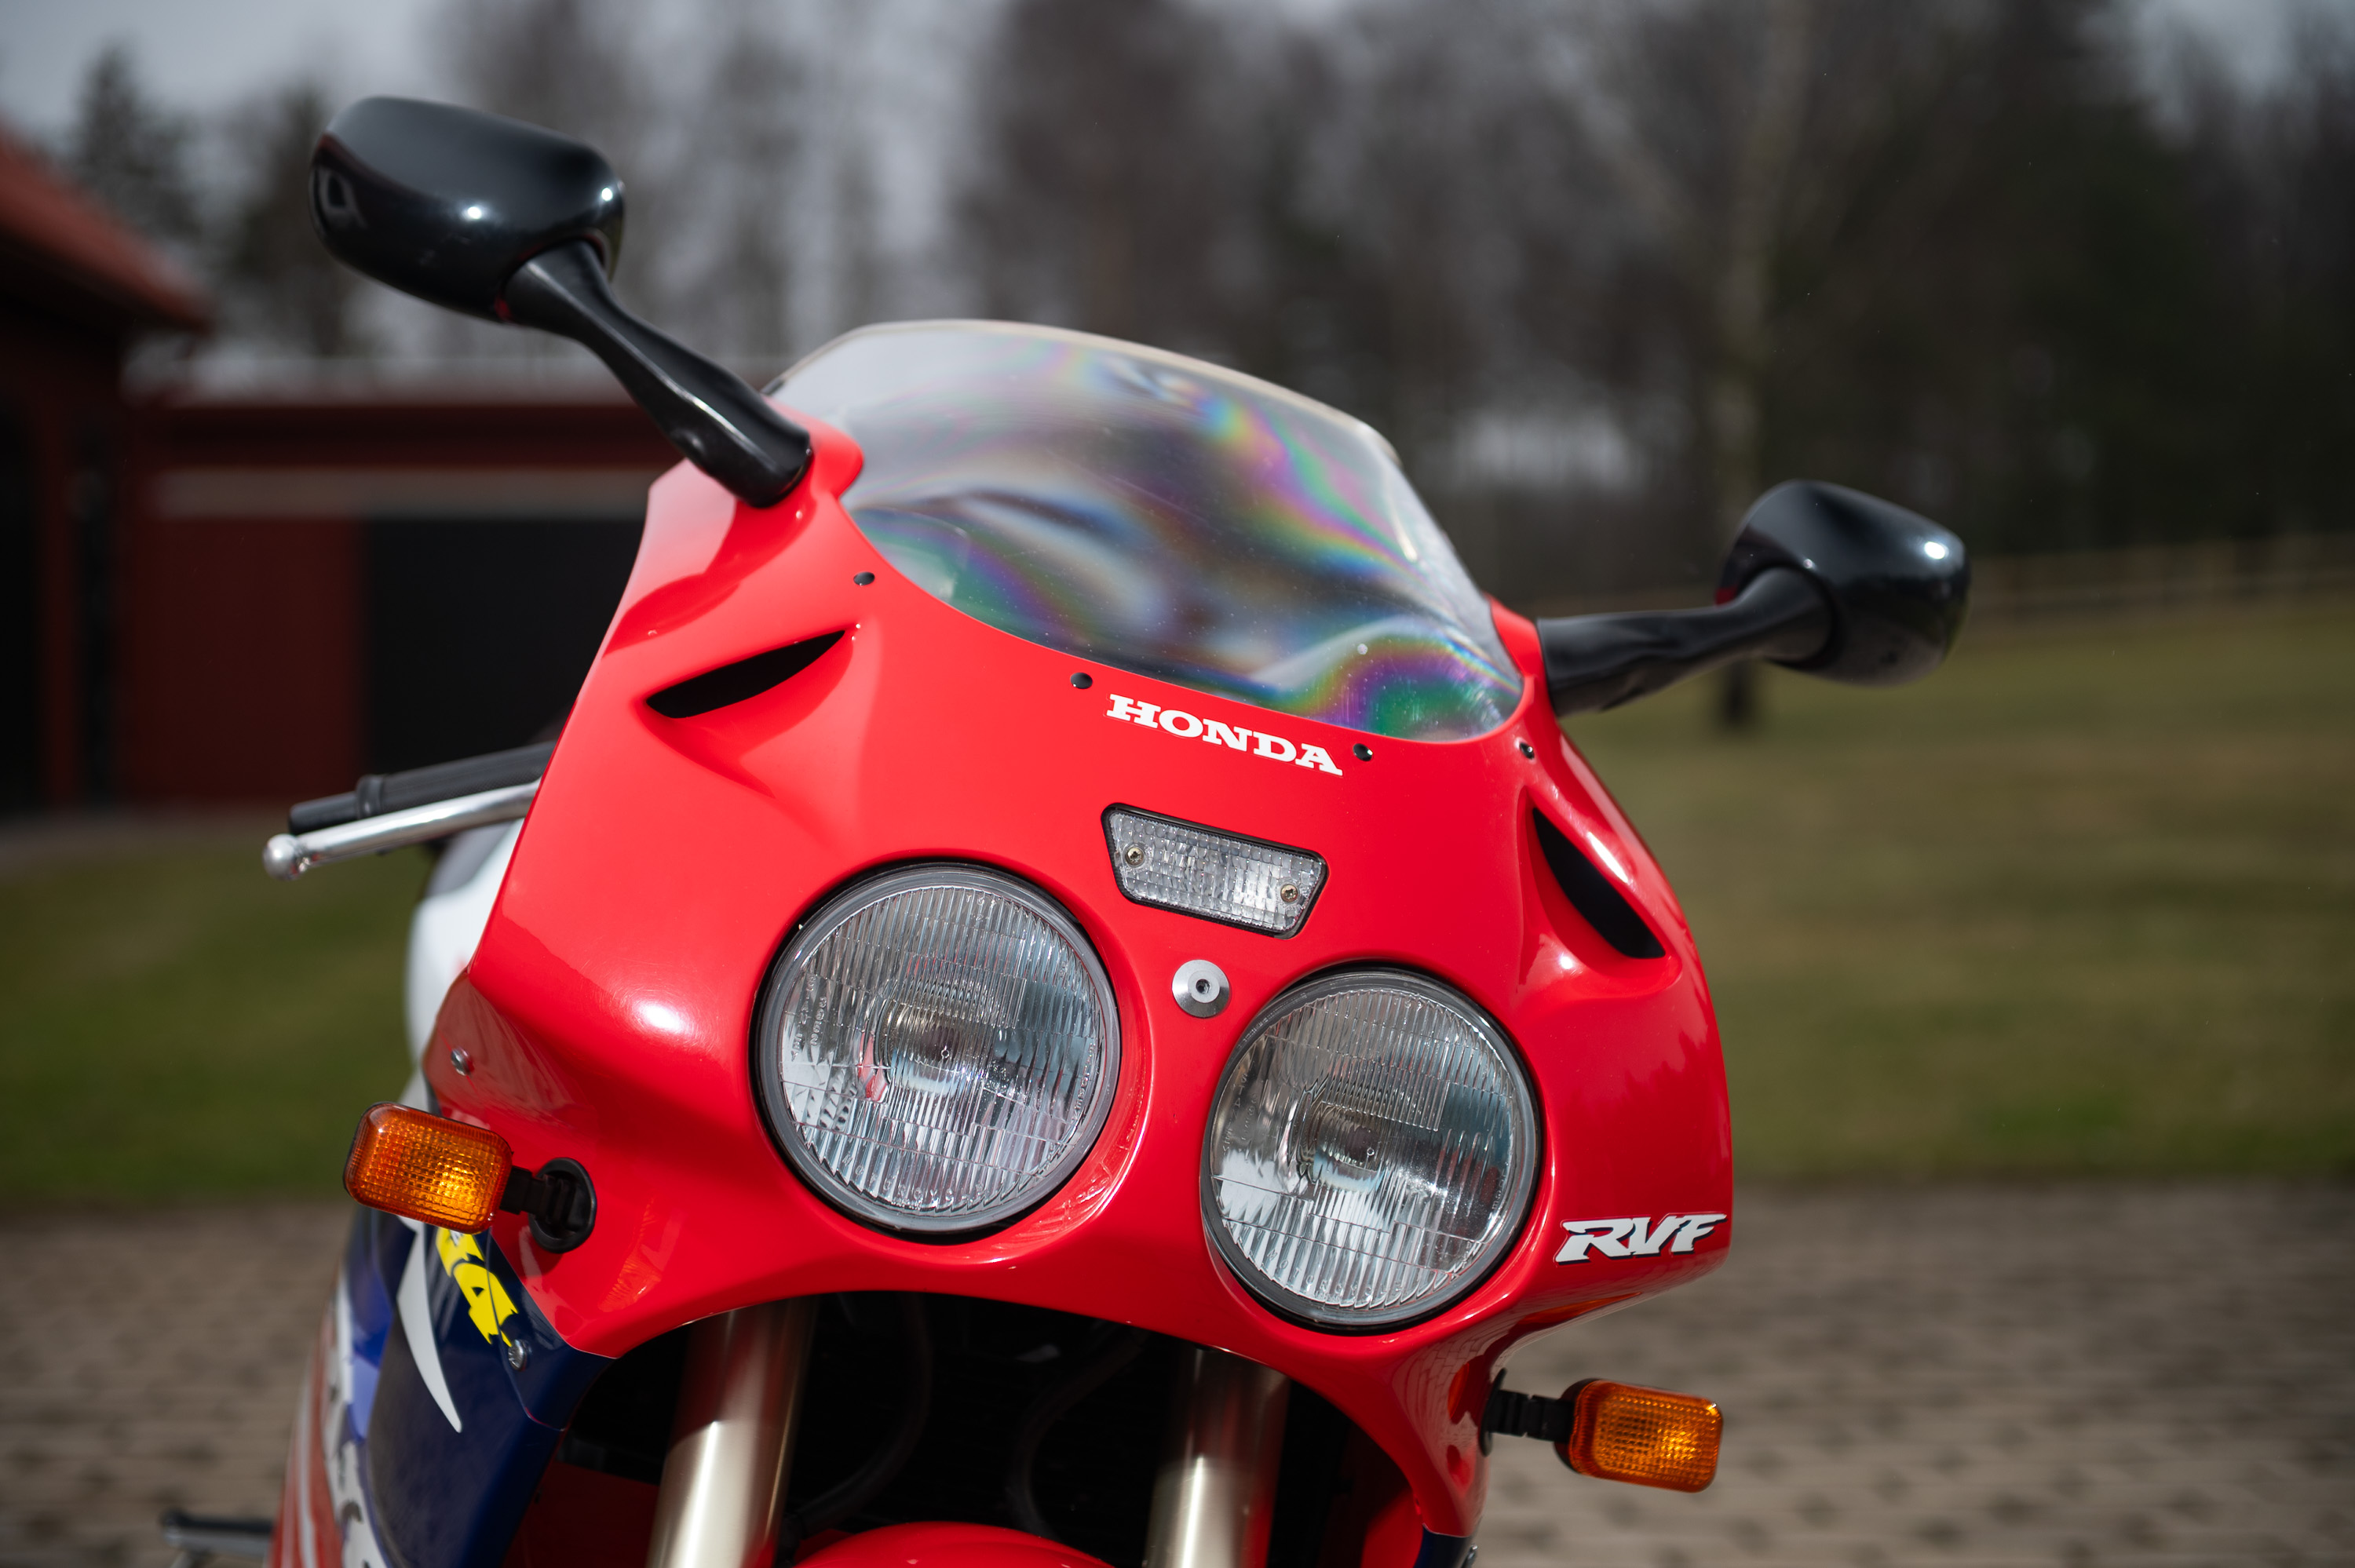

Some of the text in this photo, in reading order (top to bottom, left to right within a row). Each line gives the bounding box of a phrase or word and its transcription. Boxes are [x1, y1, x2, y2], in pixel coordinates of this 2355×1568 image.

[1106, 694, 1343, 776] HONDA
[1555, 1214, 1727, 1265] RVF
[1266, 1249, 1404, 1297] MOTORCYCLE
